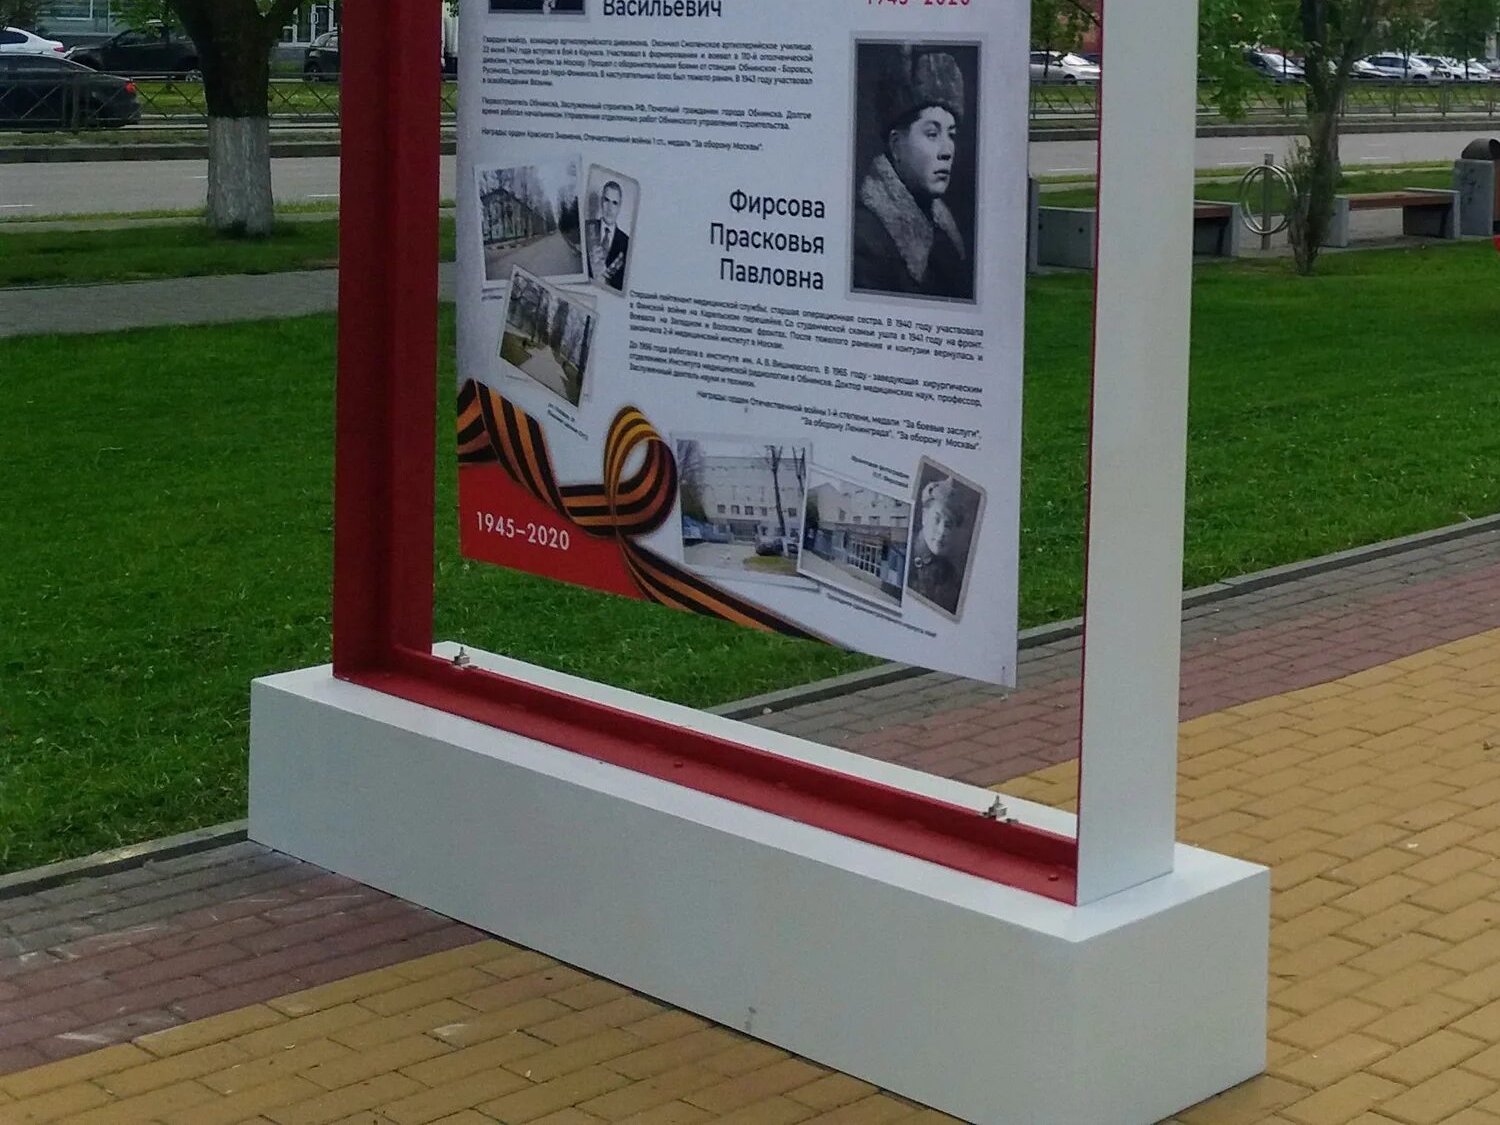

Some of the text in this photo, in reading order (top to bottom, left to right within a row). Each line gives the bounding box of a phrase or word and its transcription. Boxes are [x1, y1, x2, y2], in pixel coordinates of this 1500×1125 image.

[728, 188, 825, 220] Фирсова
[710, 222, 825, 255] Прасковья
[720, 258, 824, 291] Павловна
